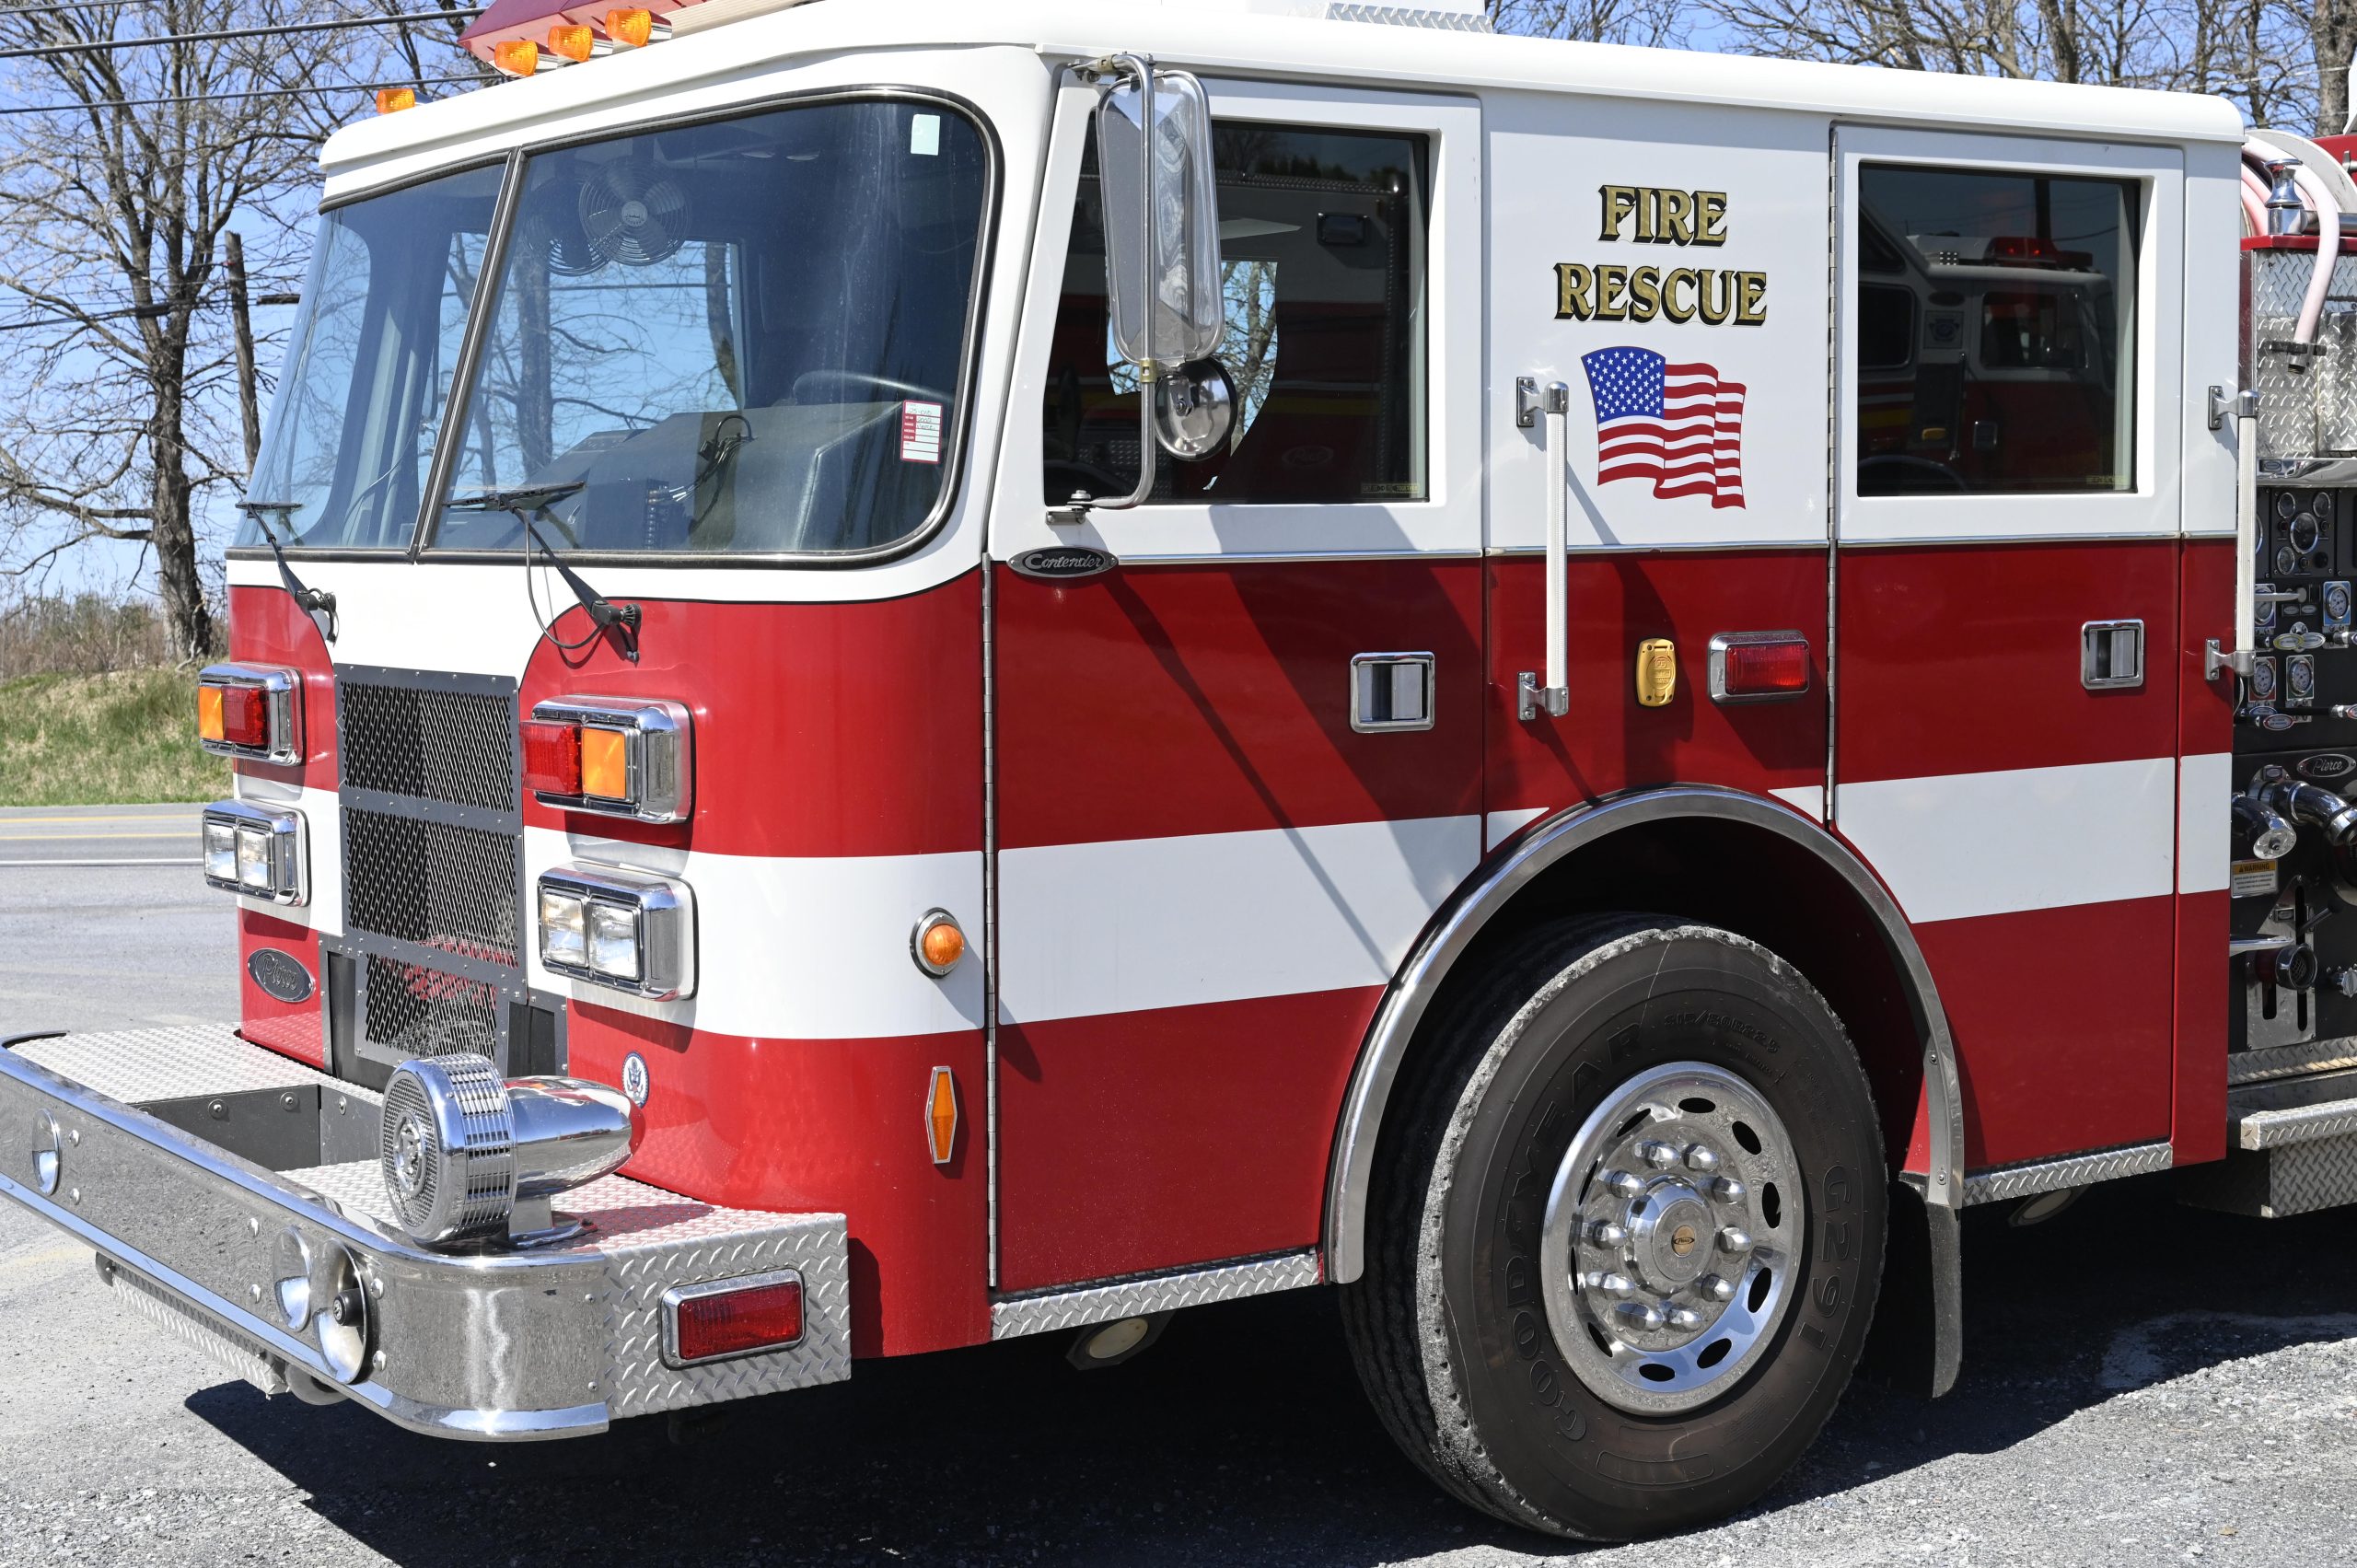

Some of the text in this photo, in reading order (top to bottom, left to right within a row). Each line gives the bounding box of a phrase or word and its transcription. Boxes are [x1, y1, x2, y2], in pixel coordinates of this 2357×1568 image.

[1597, 184, 1728, 247] FIRE
[1553, 262, 1768, 327] RESCUE
[1025, 554, 1101, 570] Contender
[2312, 758, 2343, 774] Pierce
[2244, 863, 2270, 872] WARNING
[1504, 1022, 1643, 1441] GOODYEAR
[1798, 1166, 1852, 1349] G291
